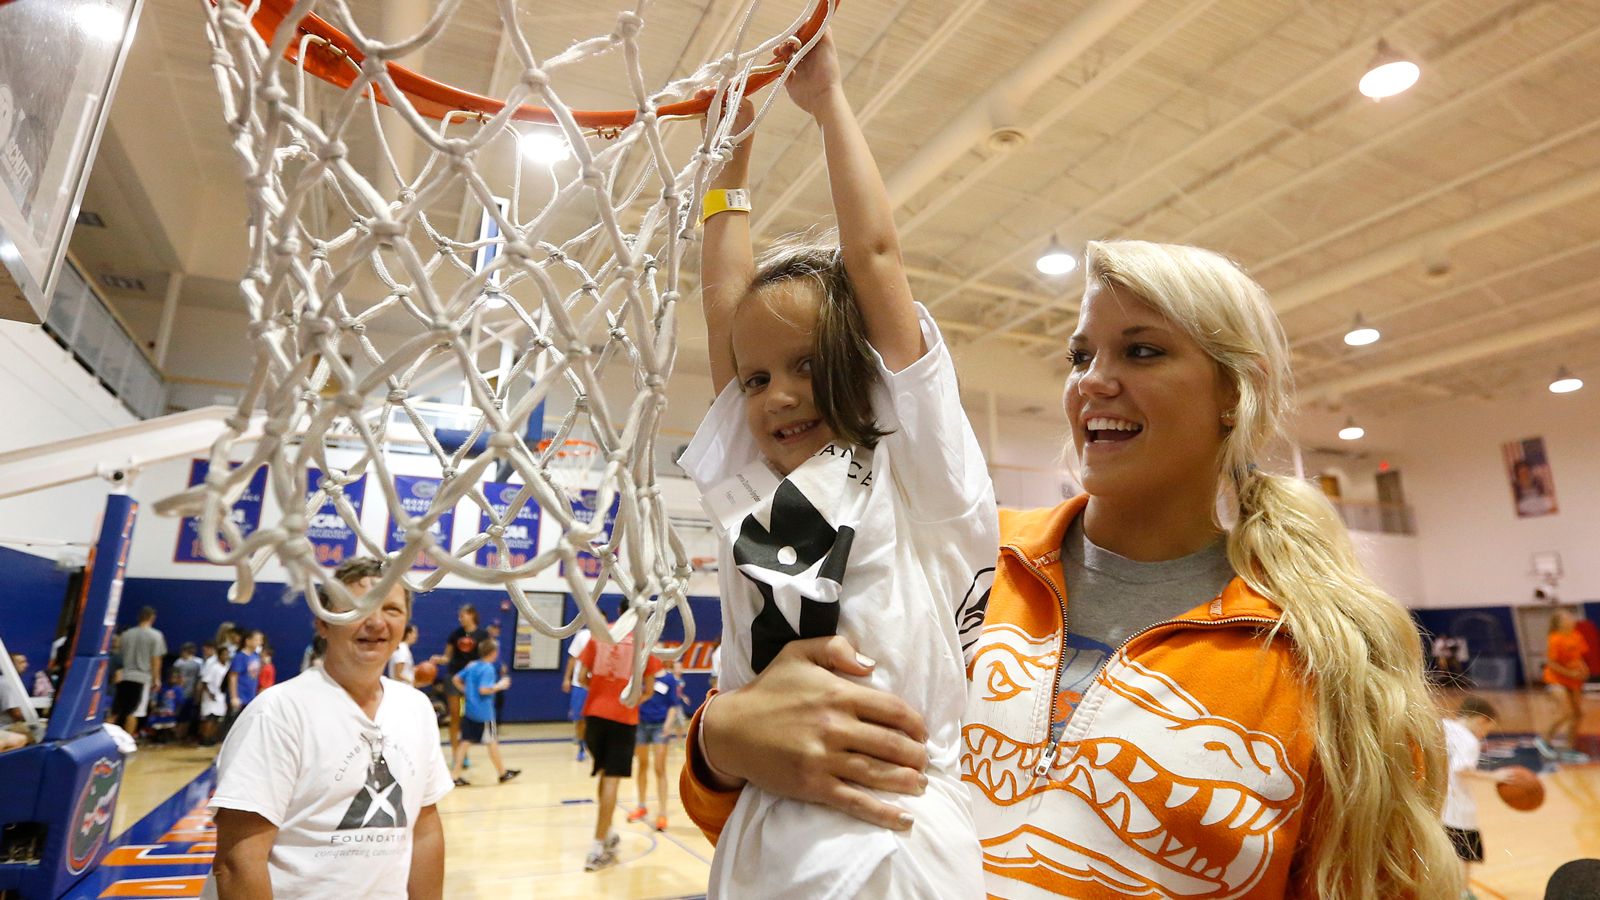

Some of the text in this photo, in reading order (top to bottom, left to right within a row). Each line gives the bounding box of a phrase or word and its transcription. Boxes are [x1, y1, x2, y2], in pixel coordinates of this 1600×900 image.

[814, 443, 873, 492] ANCE
[334, 745, 361, 782] CLIMB
[330, 834, 407, 844] FOUNDATI
